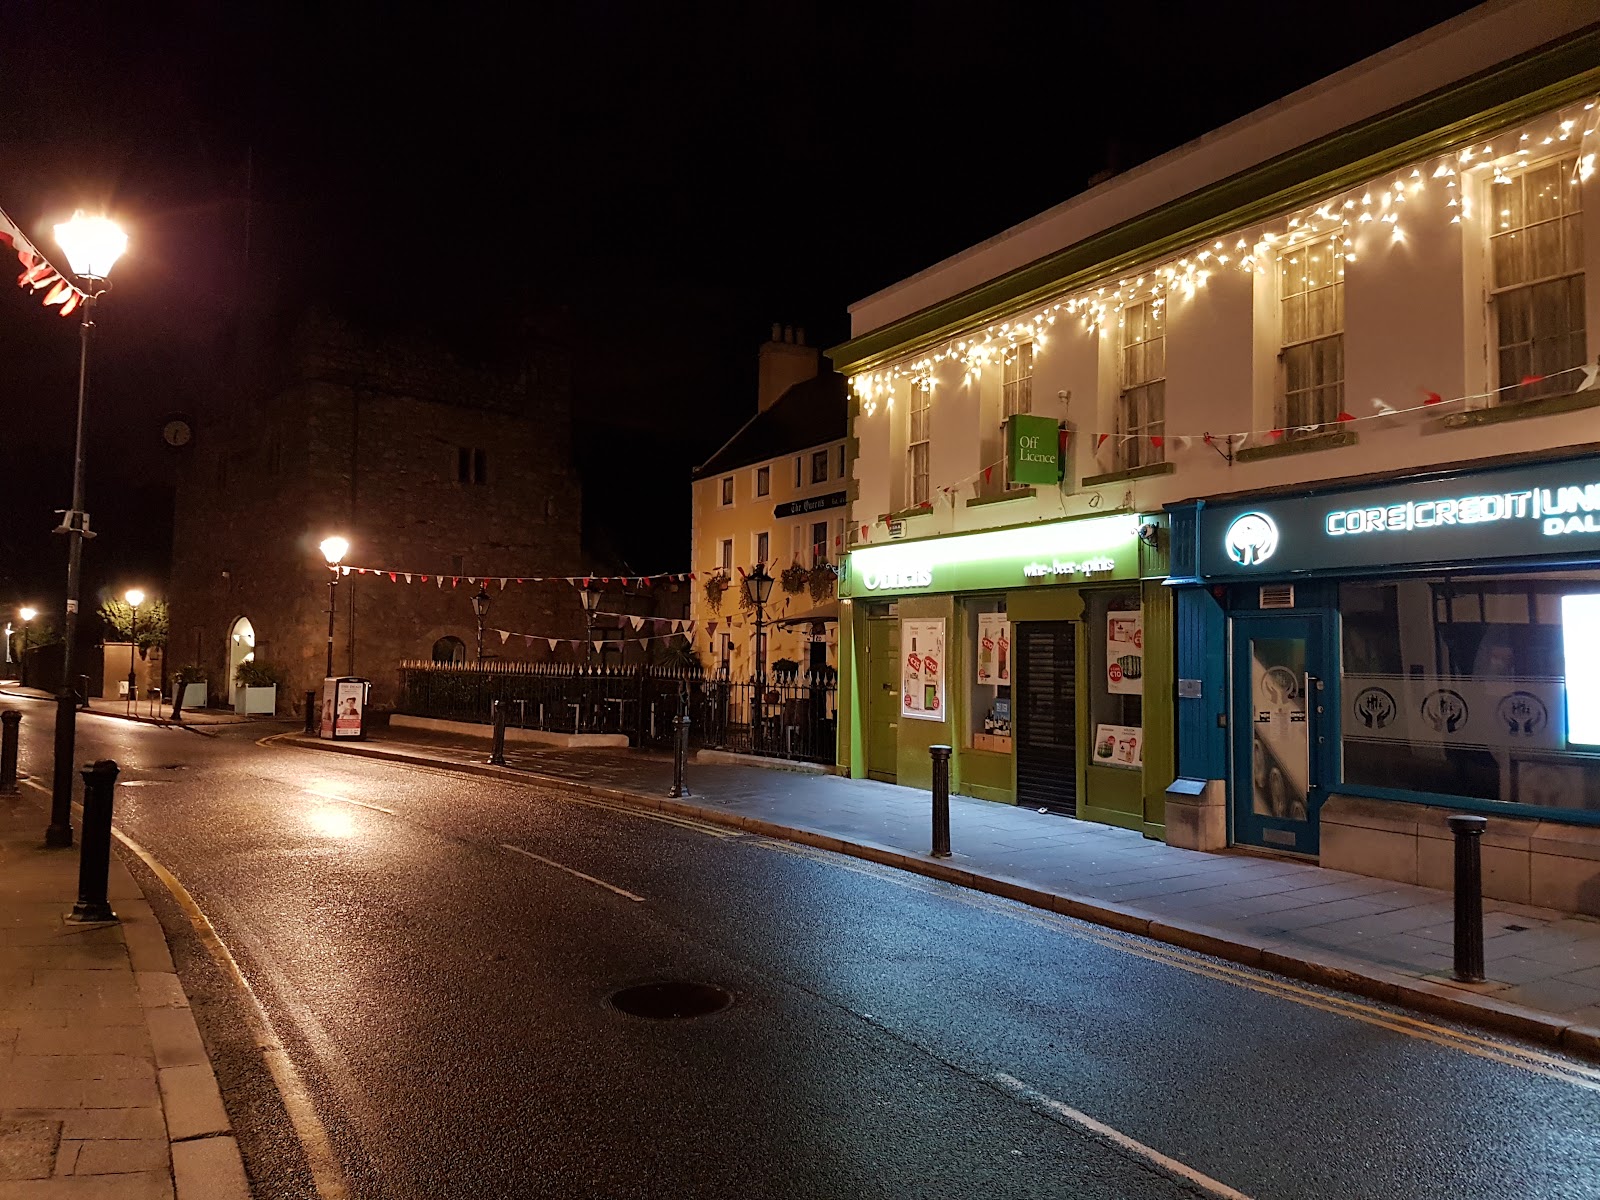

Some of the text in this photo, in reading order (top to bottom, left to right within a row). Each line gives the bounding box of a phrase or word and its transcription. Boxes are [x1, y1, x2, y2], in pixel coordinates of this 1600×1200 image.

[1019, 435, 1040, 449] Off
[1020, 448, 1056, 463] Licence
[790, 502, 802, 514] The
[1023, 556, 1115, 577] wine beer spirits
